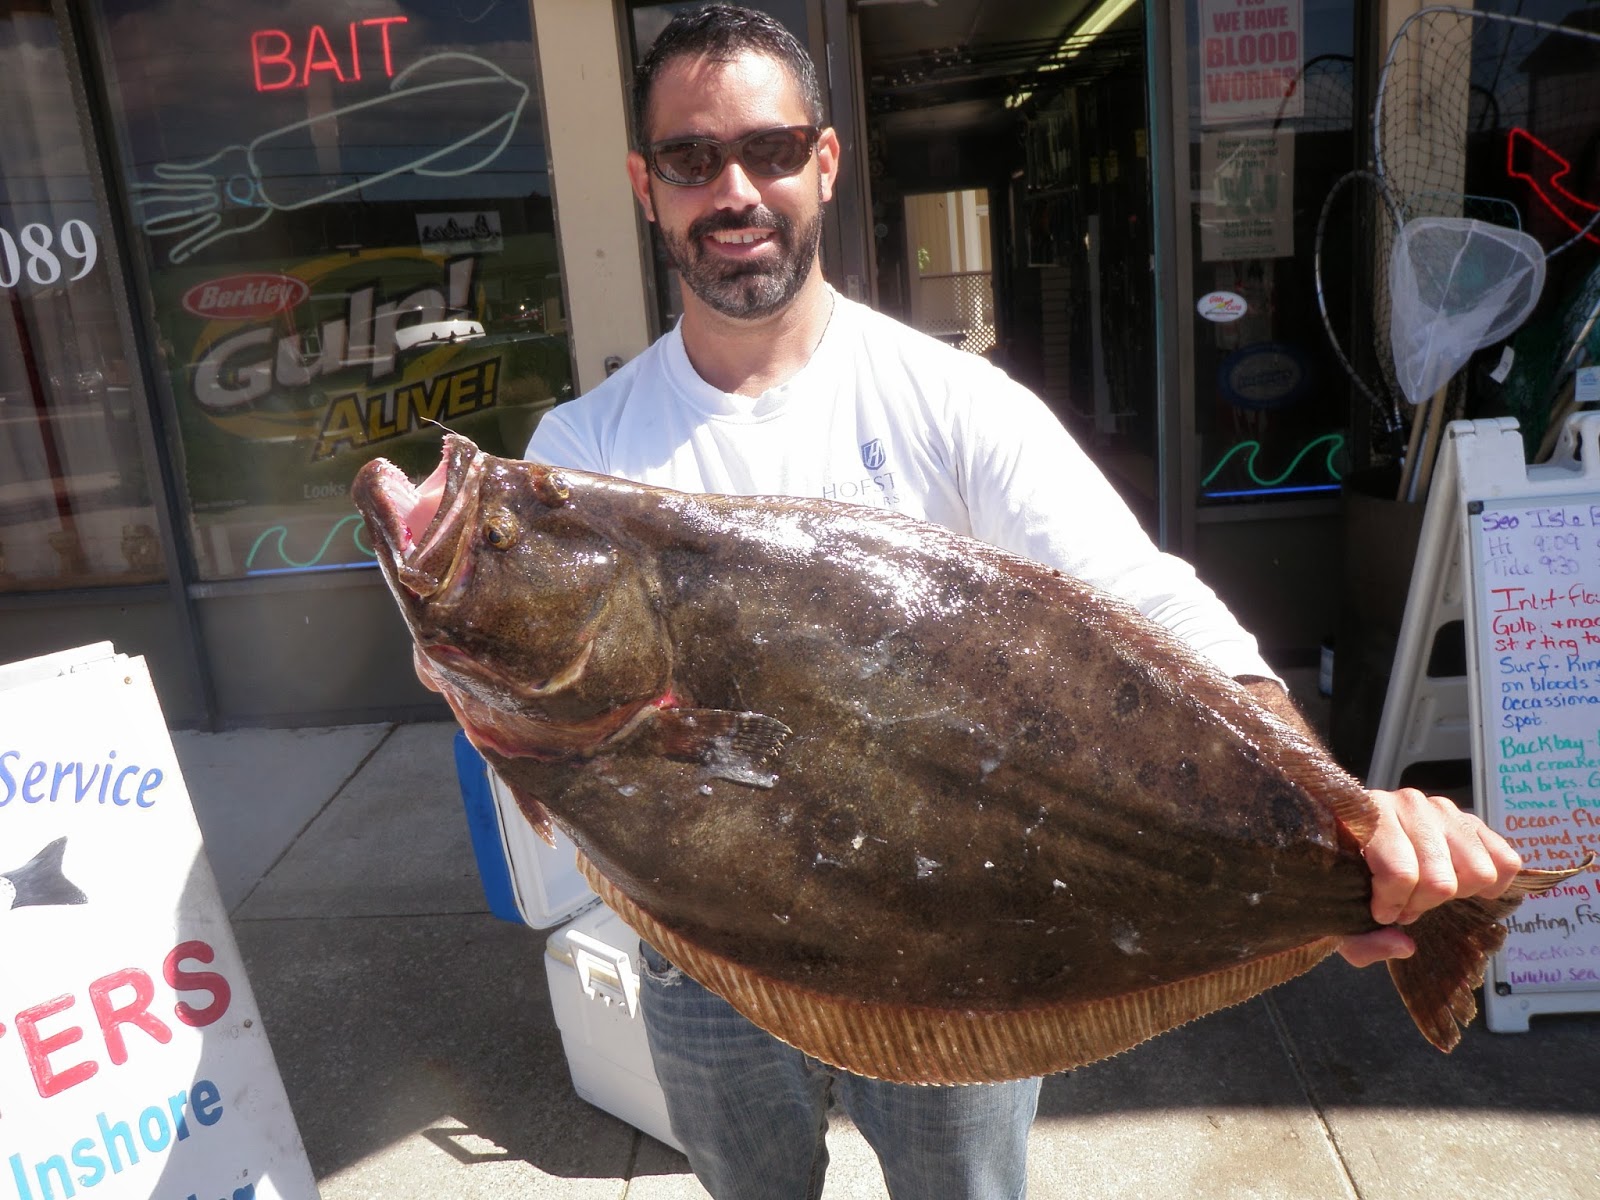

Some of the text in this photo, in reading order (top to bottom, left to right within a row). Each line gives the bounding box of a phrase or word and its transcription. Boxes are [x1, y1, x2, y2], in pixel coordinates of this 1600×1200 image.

[1212, 6, 1289, 33] WE HAVE
[251, 16, 409, 92] BAIT
[1205, 31, 1297, 68] BLOOD
[0, 219, 98, 287] 089
[199, 279, 297, 313] Berkley
[193, 257, 476, 408] Gulp!
[313, 357, 500, 460] ALIVE!
[303, 481, 346, 500] Looks
[1485, 555, 1533, 577] Tide
[1501, 676, 1589, 693] on bloods
[0, 750, 164, 808] Service
[1498, 759, 1533, 774] and
[1500, 775, 1533, 794] fish
[1520, 849, 1542, 864] ut
[0, 940, 231, 1098] ERS
[9, 1079, 224, 1200] Inshore
